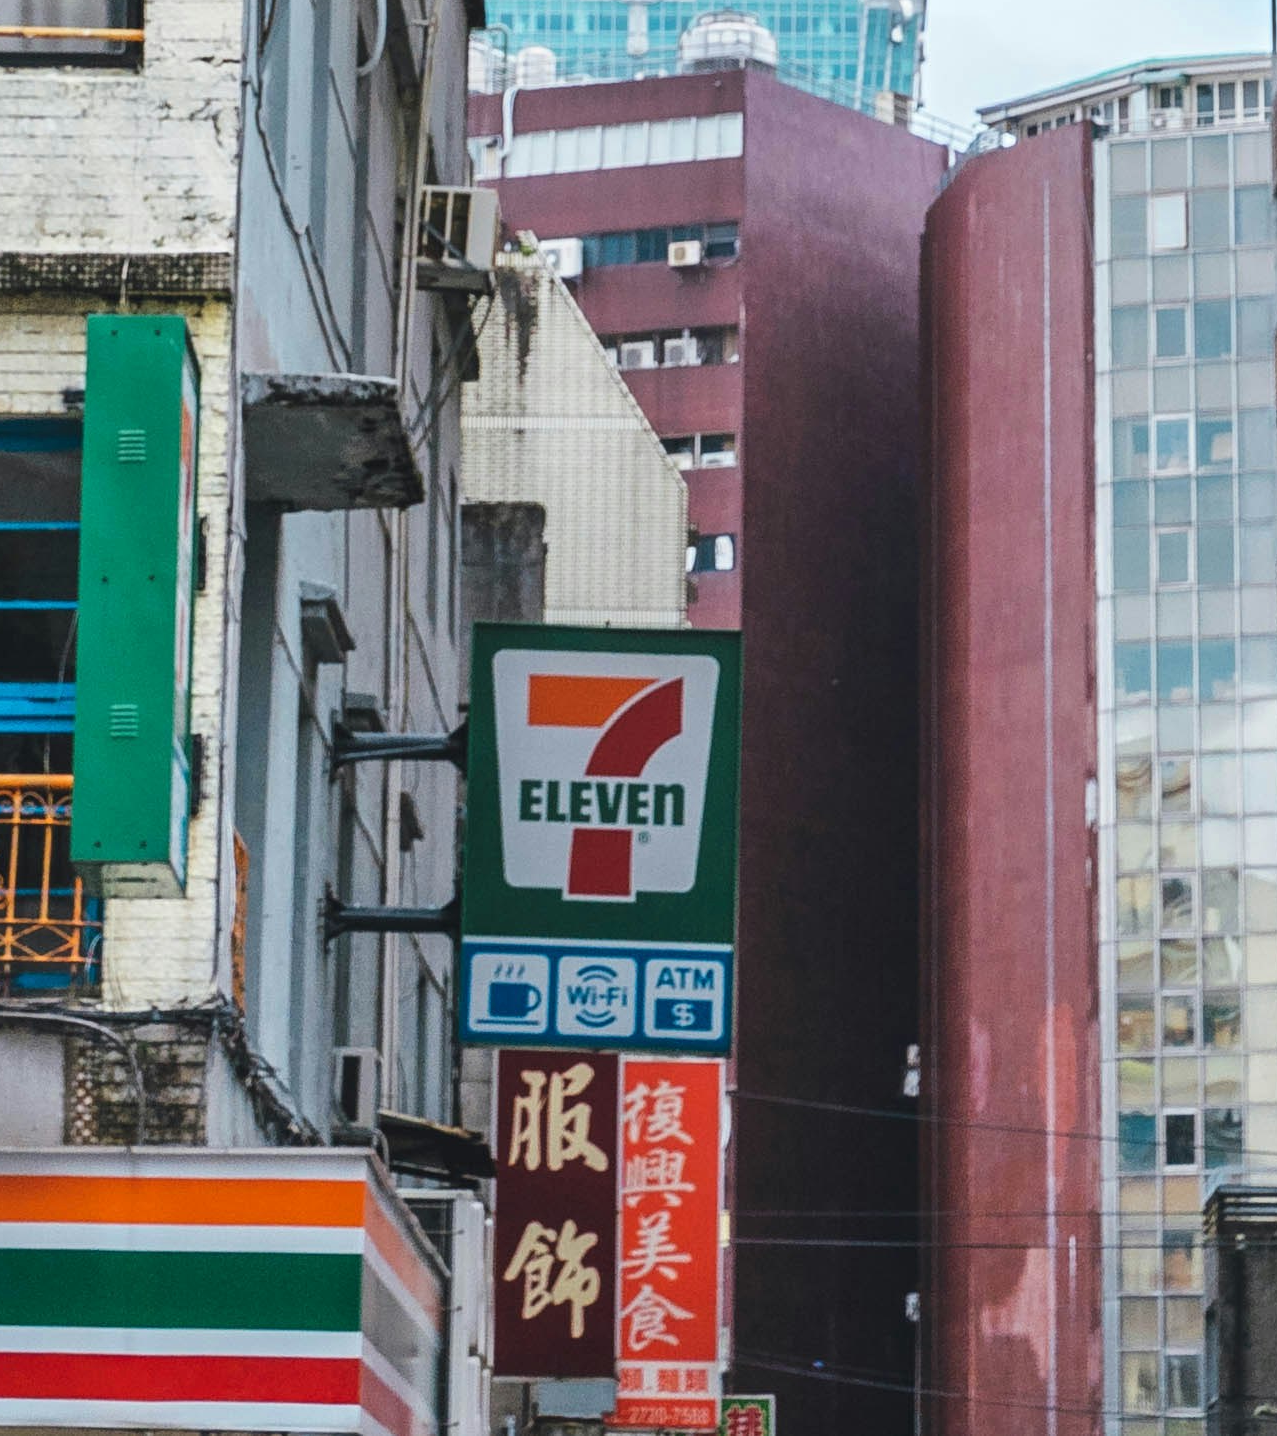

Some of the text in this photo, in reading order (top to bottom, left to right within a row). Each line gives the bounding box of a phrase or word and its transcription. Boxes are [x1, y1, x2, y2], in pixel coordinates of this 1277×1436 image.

[567, 985, 628, 1007] Wi-Fi
[656, 967, 715, 990] ATM
[503, 1062, 609, 1339] 服飾
[622, 1080, 696, 1352] 復興美食
